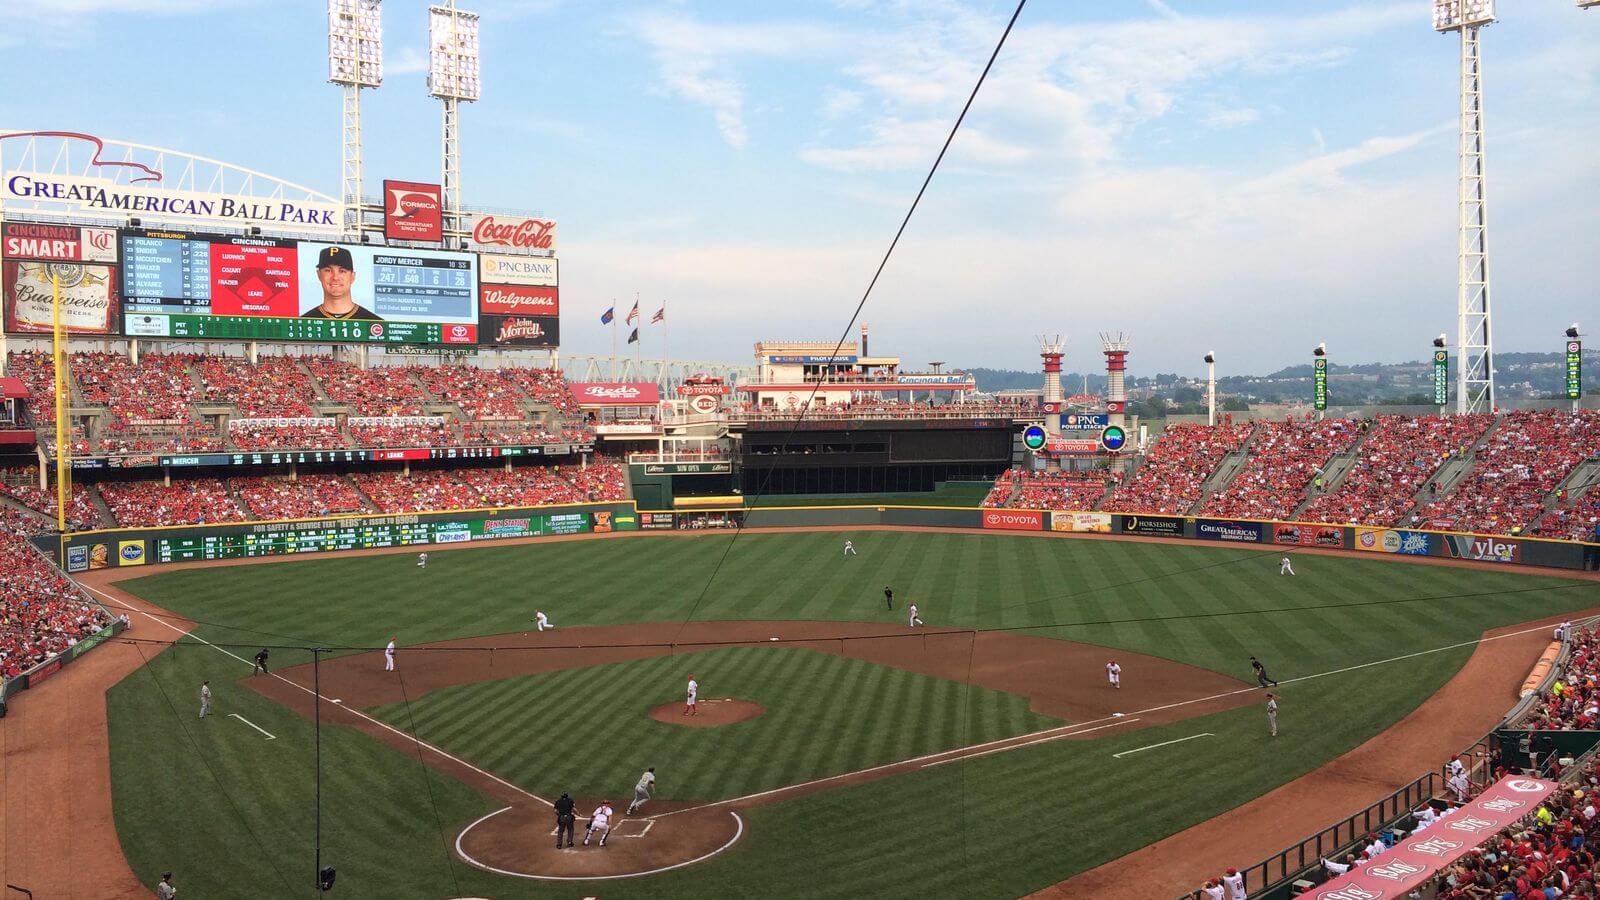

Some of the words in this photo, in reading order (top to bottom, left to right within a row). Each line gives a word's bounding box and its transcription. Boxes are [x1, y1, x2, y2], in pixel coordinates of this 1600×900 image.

[9, 175, 97, 201] GREAT
[219, 198, 276, 221] BALL
[280, 203, 336, 226] PARK
[401, 200, 436, 209] FORMICA
[8, 238, 77, 257] SMART
[232, 238, 276, 246] CINCINNATI
[499, 262, 522, 272] PNC
[524, 263, 552, 273] BANK
[378, 274, 395, 282] .247
[484, 290, 554, 308] Walgreens
[353, 328, 361, 337] 0
[496, 323, 545, 341] Morrell
[584, 386, 640, 397] Reds
[1078, 416, 1100, 424] PNC
[484, 519, 503, 533] PENN
[504, 518, 530, 531] STATION
[1002, 515, 1037, 525] TOYOTA
[296, 522, 321, 530] SERVICE
[1200, 525, 1224, 533] GREAT
[1221, 528, 1258, 536] AMERICAN
[1444, 534, 1517, 559] Wyler
[1415, 840, 1458, 855] 1975
[1373, 863, 1418, 880] 1940
